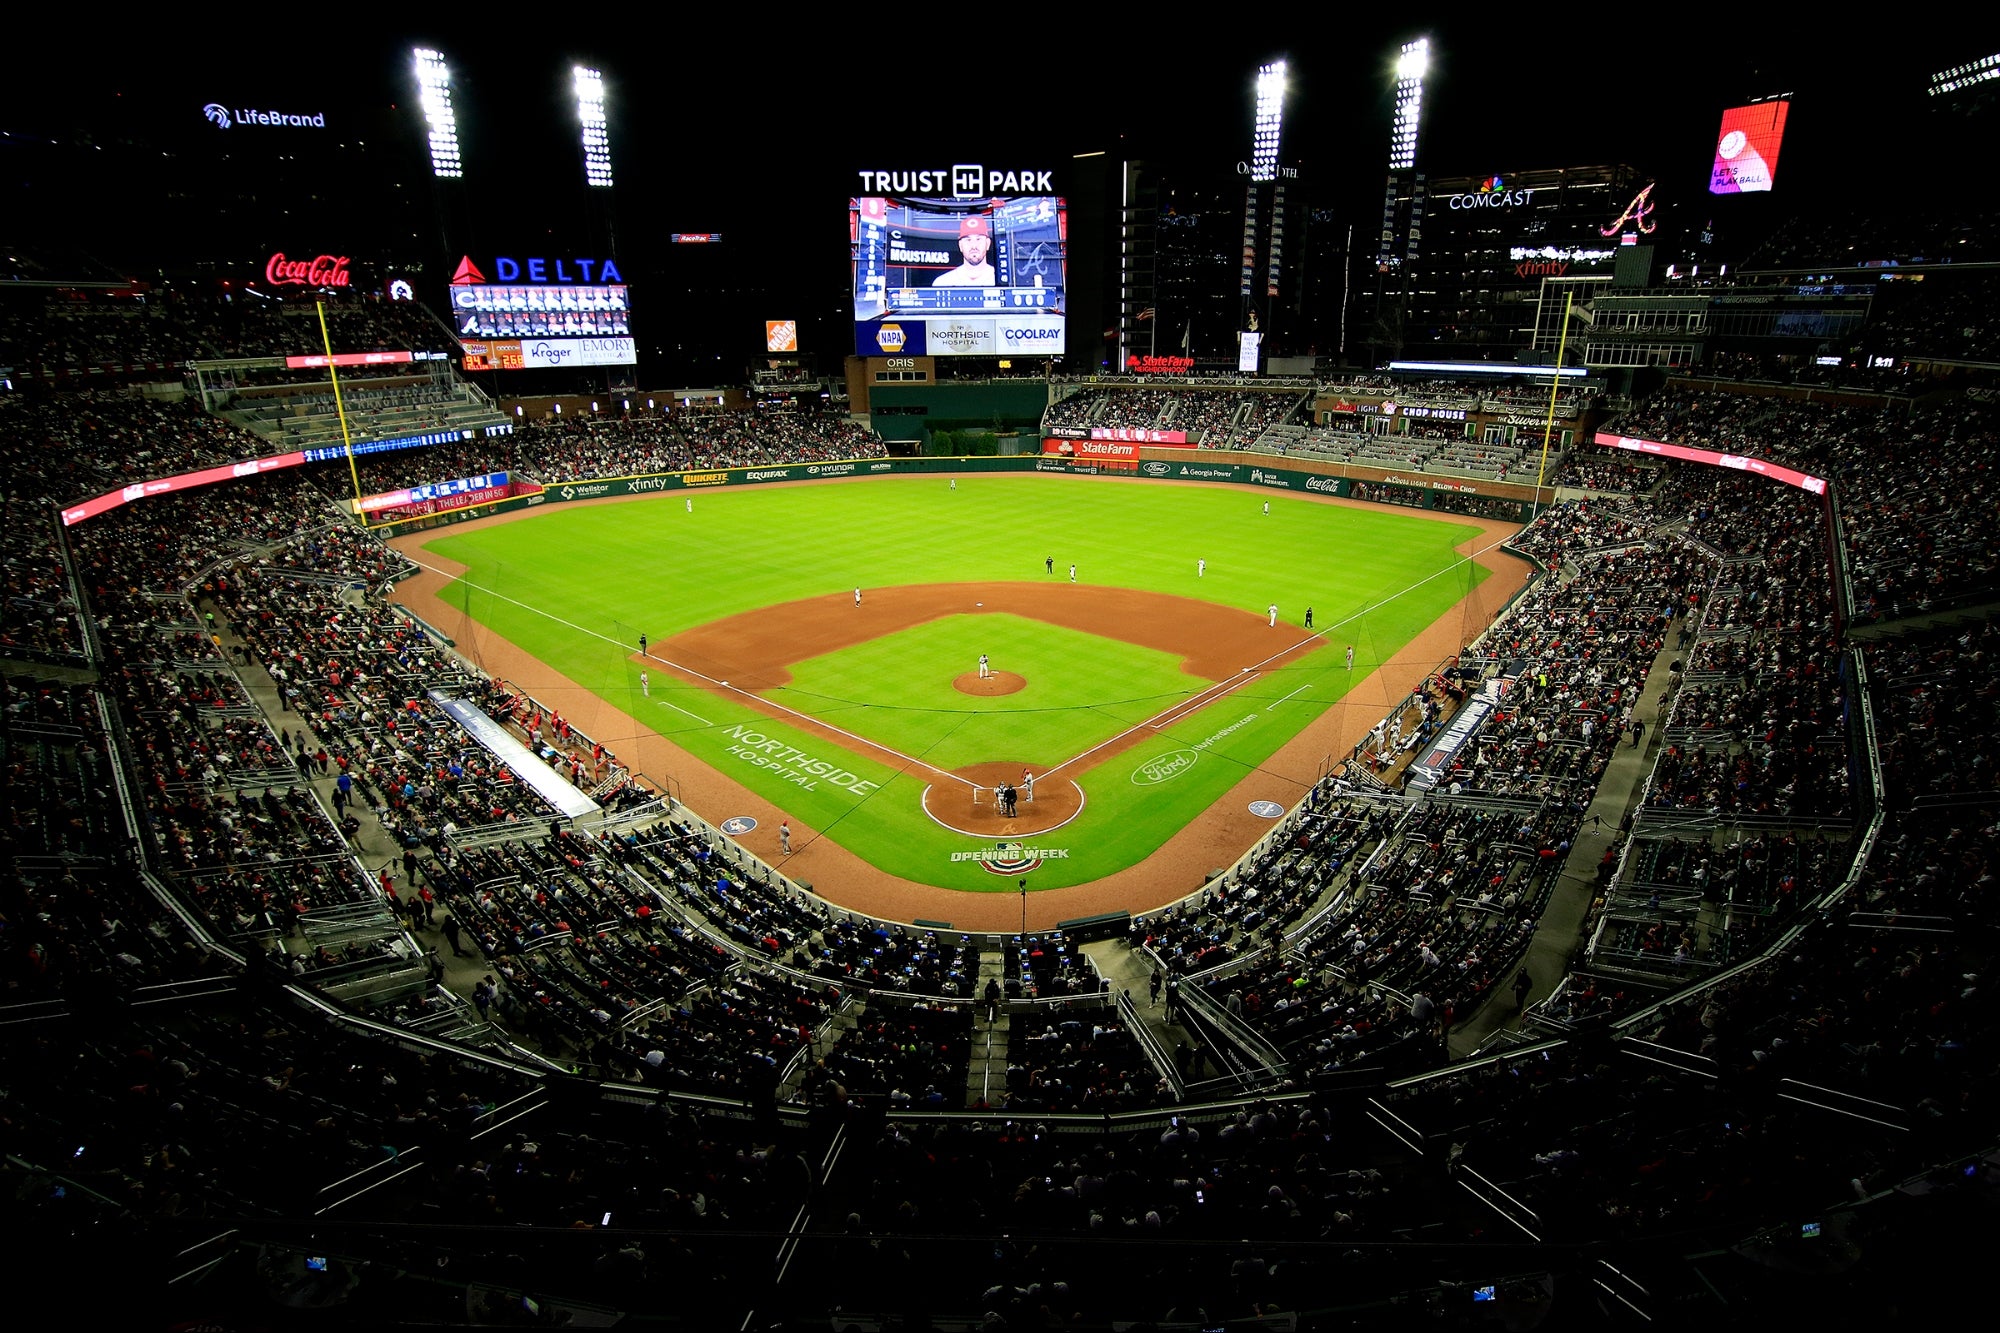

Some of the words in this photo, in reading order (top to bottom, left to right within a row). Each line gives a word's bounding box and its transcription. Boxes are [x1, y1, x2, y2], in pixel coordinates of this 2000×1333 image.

[235, 108, 325, 127] LifeBrand
[1714, 168, 1738, 177] LET'S
[859, 171, 948, 192] TRUIST
[989, 171, 1053, 192] PARK
[1716, 176, 1738, 186] PLAY
[1740, 176, 1762, 184] BALL
[1450, 190, 1534, 210] COMCAST
[890, 249, 949, 263] MOUSTAKAS
[495, 257, 622, 282] DELTA
[1514, 260, 1569, 278] xfinity
[881, 332, 903, 344] NAPA
[1005, 328, 1061, 339] COOLRAY
[583, 339, 631, 352] EMORY
[503, 355, 523, 364] 268
[532, 342, 571, 364] Kroger
[887, 358, 914, 367] ORIS
[1356, 404, 1378, 413] LIGHT
[1403, 407, 1429, 418] CHOP
[1432, 410, 1465, 420] HOUSE
[821, 464, 855, 472] HYUNDAI
[1190, 468, 1208, 477] Georgia
[1209, 469, 1232, 478] Power
[683, 473, 729, 484] QUIKRETE
[746, 470, 788, 480] EQUIFAX
[576, 484, 609, 493] Wellstar
[627, 478, 667, 493] xfinity
[1433, 482, 1453, 490] BELOW
[1460, 485, 1476, 493] CHOP
[440, 498, 455, 508] THE
[484, 491, 493, 499] IN
[722, 724, 881, 796] NORTHSIDE
[725, 744, 818, 792] HOSPITAL
[1142, 754, 1190, 781] Ford
[950, 850, 1020, 862] OPENING
[1023, 848, 1069, 860] WEEK
